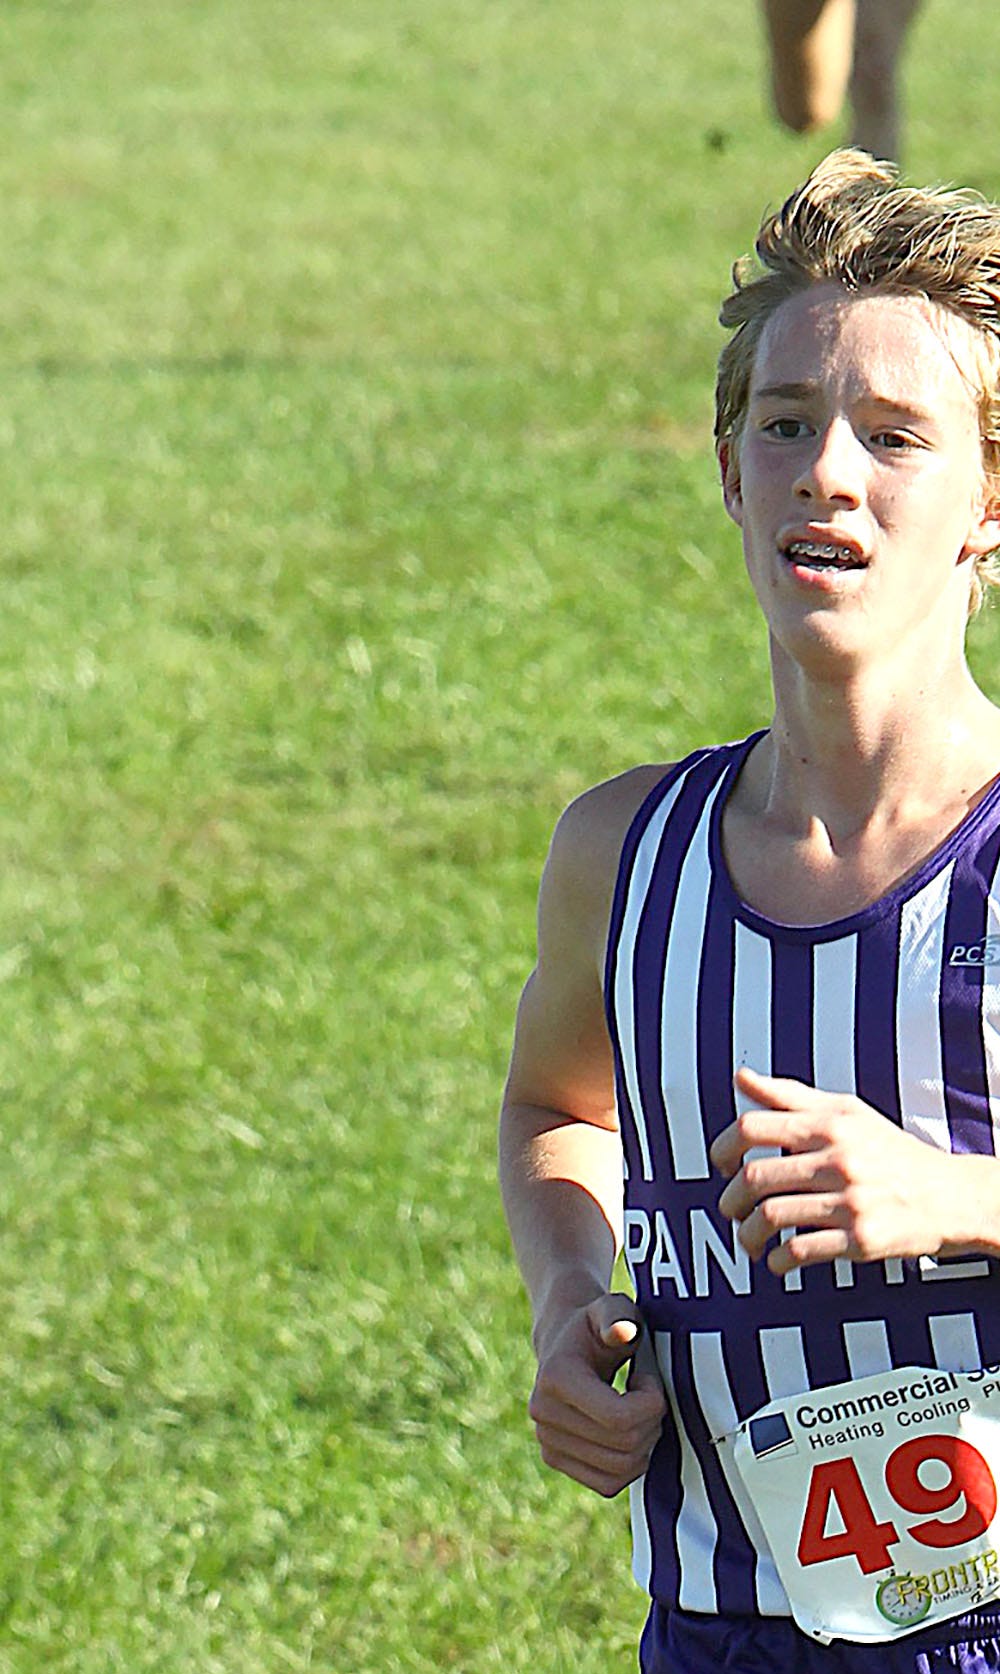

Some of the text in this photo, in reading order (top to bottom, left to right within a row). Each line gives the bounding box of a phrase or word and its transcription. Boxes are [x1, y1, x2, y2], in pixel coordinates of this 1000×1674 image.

[796, 1371, 959, 1429] Commercial
[809, 1421, 884, 1450] Heating
[896, 1398, 971, 1428] Cooling
